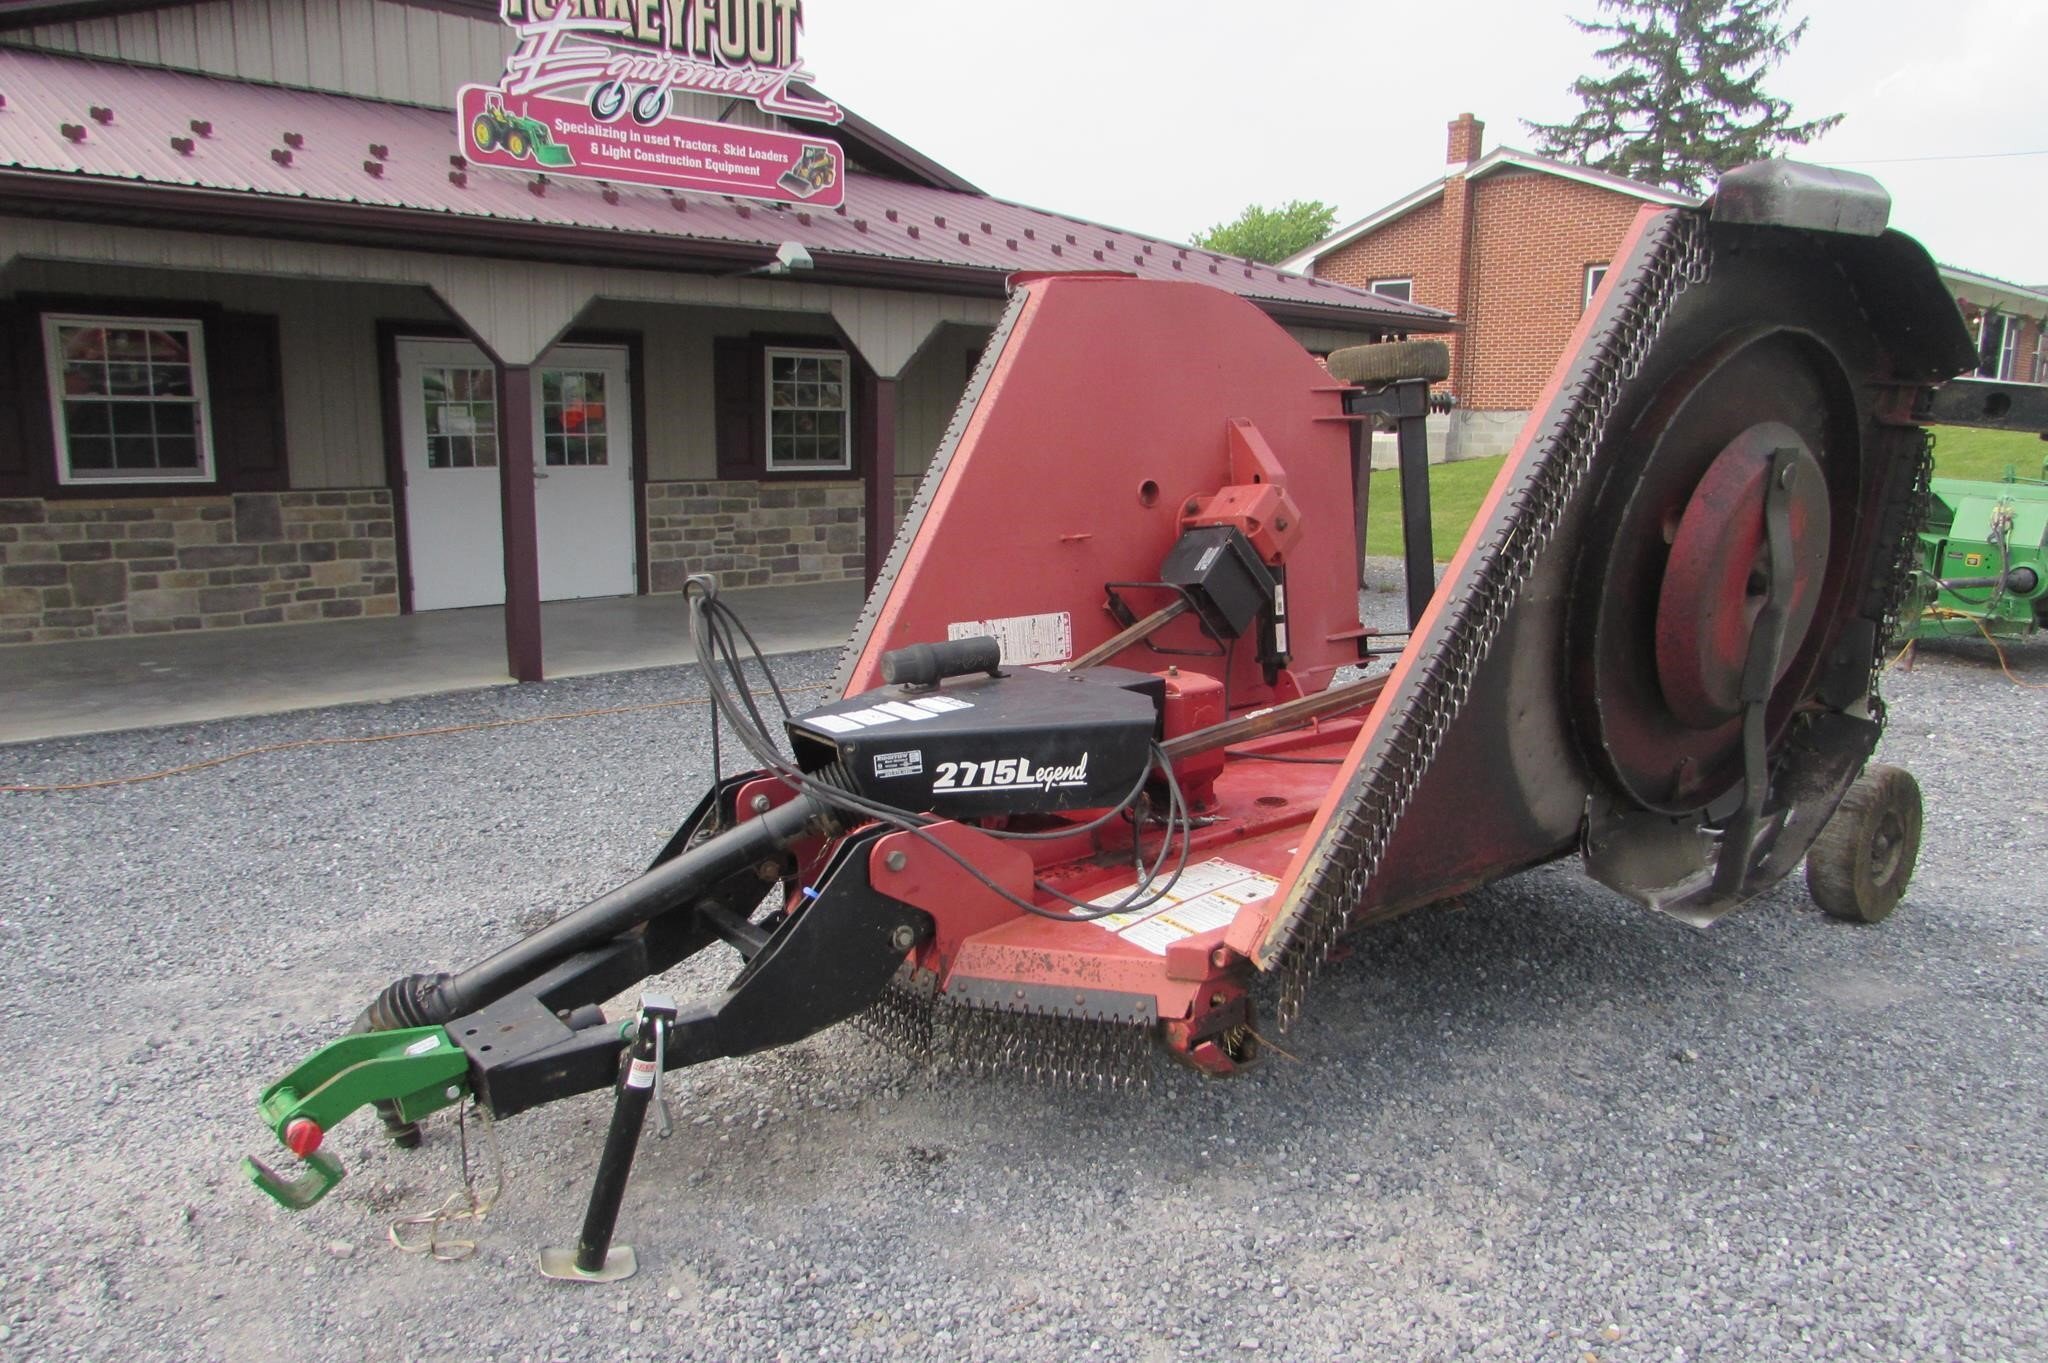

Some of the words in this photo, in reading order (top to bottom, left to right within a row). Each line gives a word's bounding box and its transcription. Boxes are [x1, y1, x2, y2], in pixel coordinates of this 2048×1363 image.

[511, 2, 838, 117] Equipment
[555, 118, 627, 143] Specializing
[630, 129, 641, 142] in
[643, 134, 670, 147] used
[673, 136, 721, 154] Tractors,
[723, 143, 746, 157] Skid
[749, 147, 789, 163] Loaders
[590, 142, 599, 155] &
[602, 143, 631, 160] Light
[634, 149, 702, 168] Construction
[705, 158, 760, 176] Equipment
